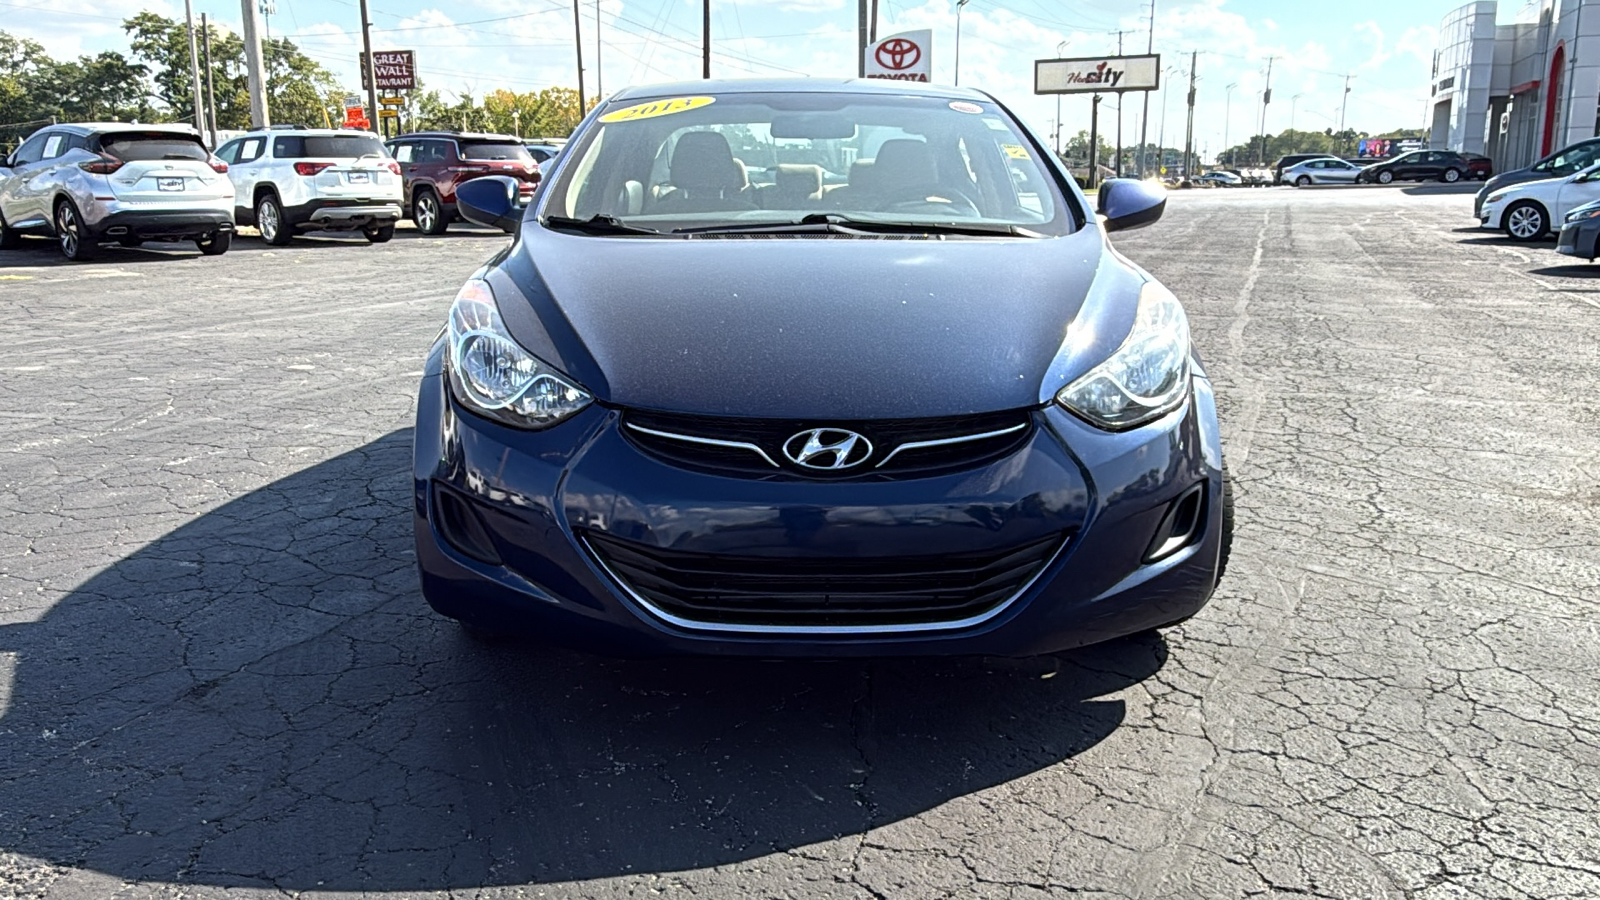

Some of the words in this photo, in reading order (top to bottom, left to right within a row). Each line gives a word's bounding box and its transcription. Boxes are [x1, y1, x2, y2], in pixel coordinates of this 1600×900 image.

[373, 53, 409, 65] GREAT
[375, 65, 409, 76] WALL
[621, 99, 693, 119] 2013
